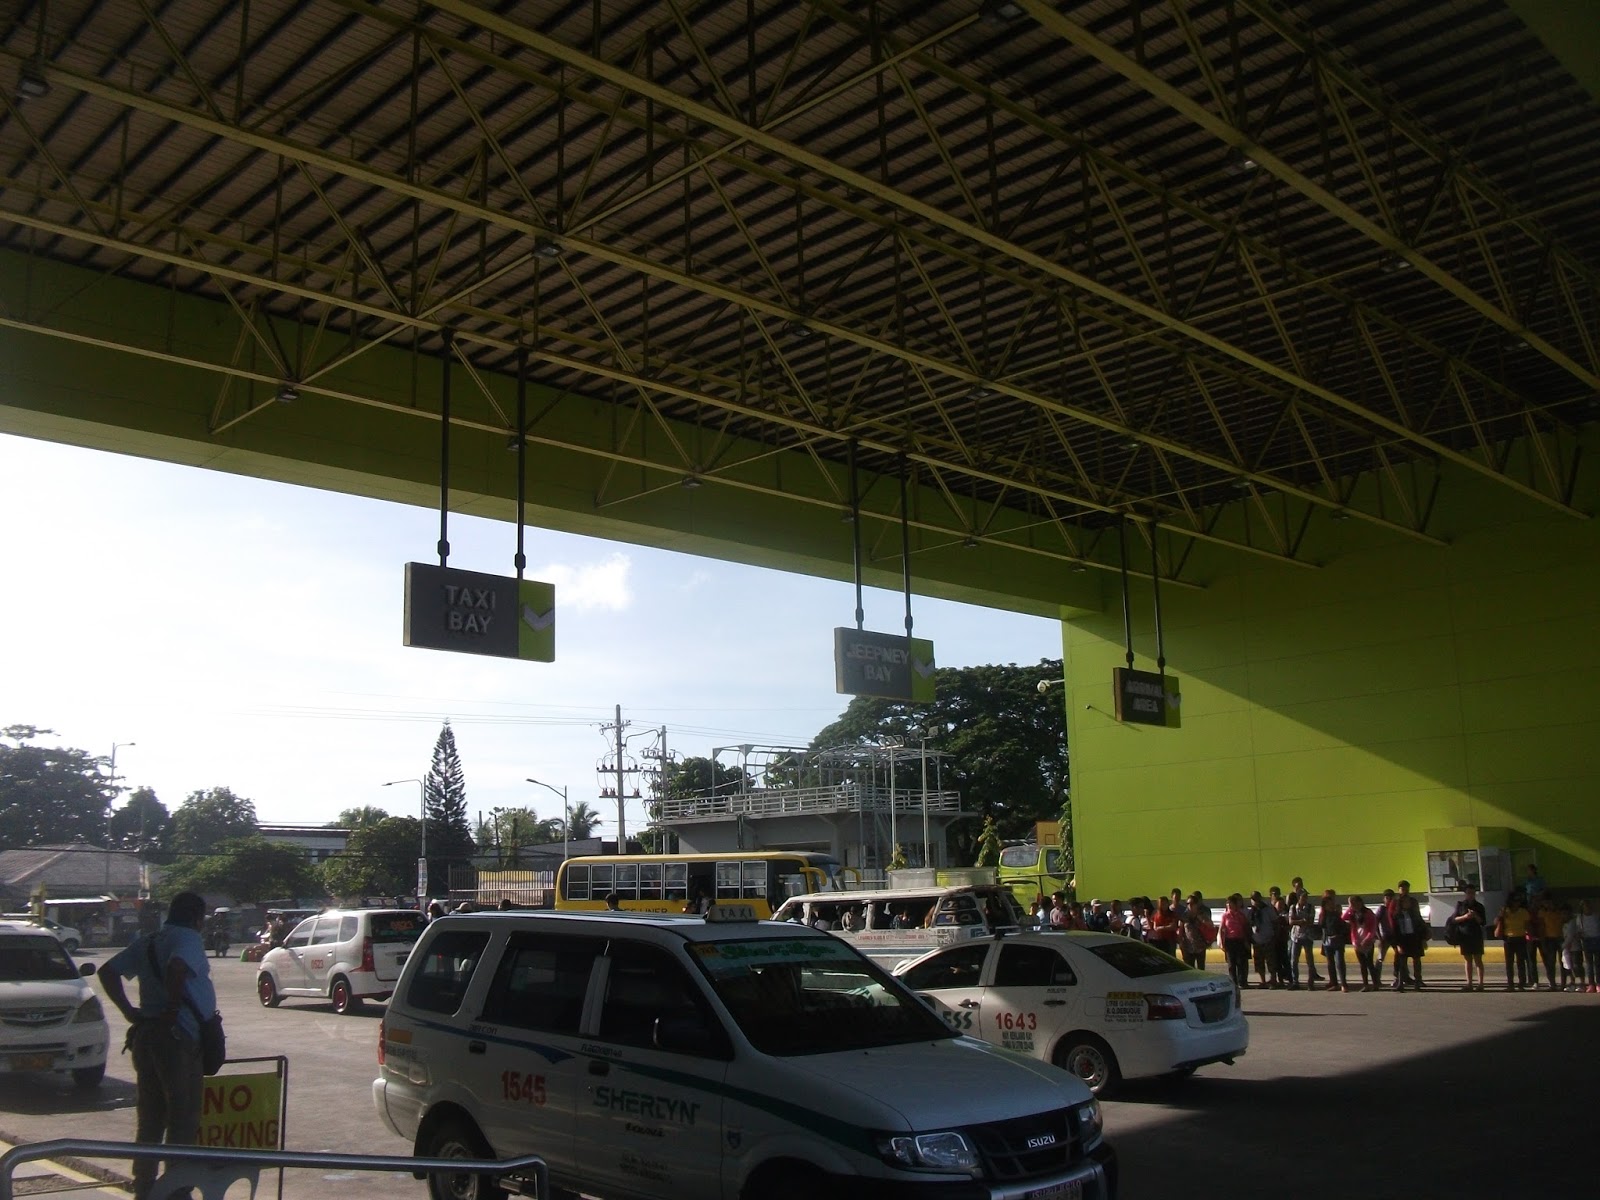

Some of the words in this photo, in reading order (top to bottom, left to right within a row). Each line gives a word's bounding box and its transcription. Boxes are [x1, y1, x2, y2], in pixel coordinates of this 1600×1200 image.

[445, 584, 496, 609] TAXI
[448, 611, 492, 634] BAY
[846, 643, 909, 664] JEEPNEY
[863, 665, 892, 682] BAY
[1132, 697, 1159, 713] AREA
[718, 907, 753, 920] TAXI
[995, 1012, 1037, 1030] 1643
[501, 1070, 546, 1105] 1545
[203, 1084, 252, 1115] NO
[195, 1119, 279, 1148] ARKING
[1027, 1134, 1056, 1148] ISUZU
